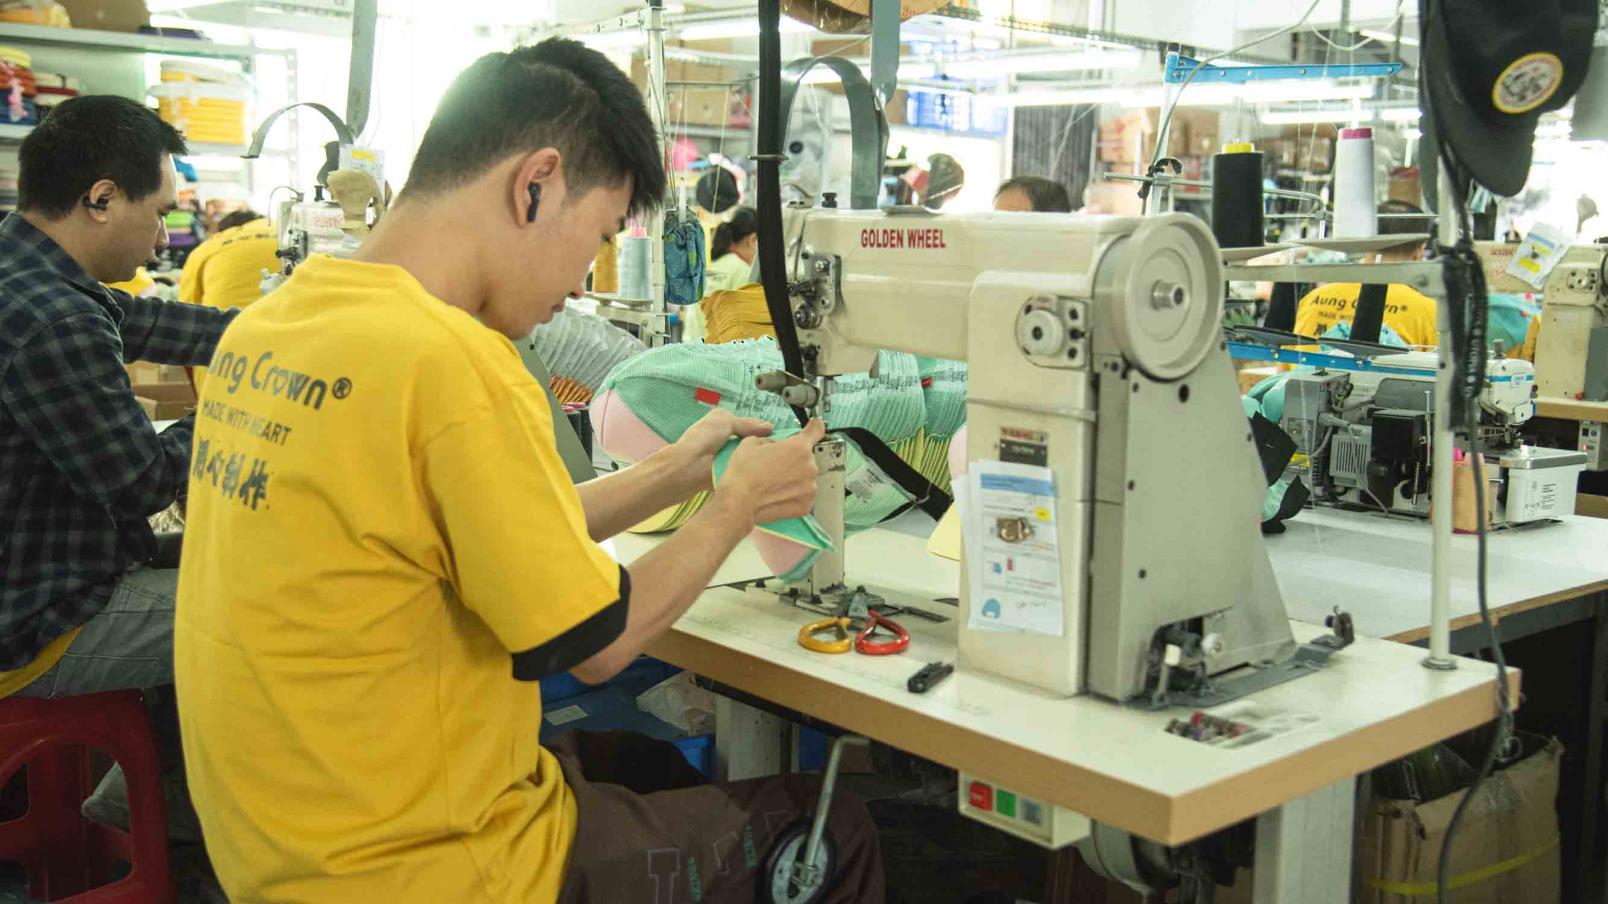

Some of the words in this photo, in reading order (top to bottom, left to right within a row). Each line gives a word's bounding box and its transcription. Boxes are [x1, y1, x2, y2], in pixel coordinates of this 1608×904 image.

[861, 229, 904, 248] GOLDEN
[907, 229, 946, 248] WHEEL
[1311, 296, 1347, 310] Aung
[203, 398, 226, 422] MADE
[227, 405, 249, 430] WITH
